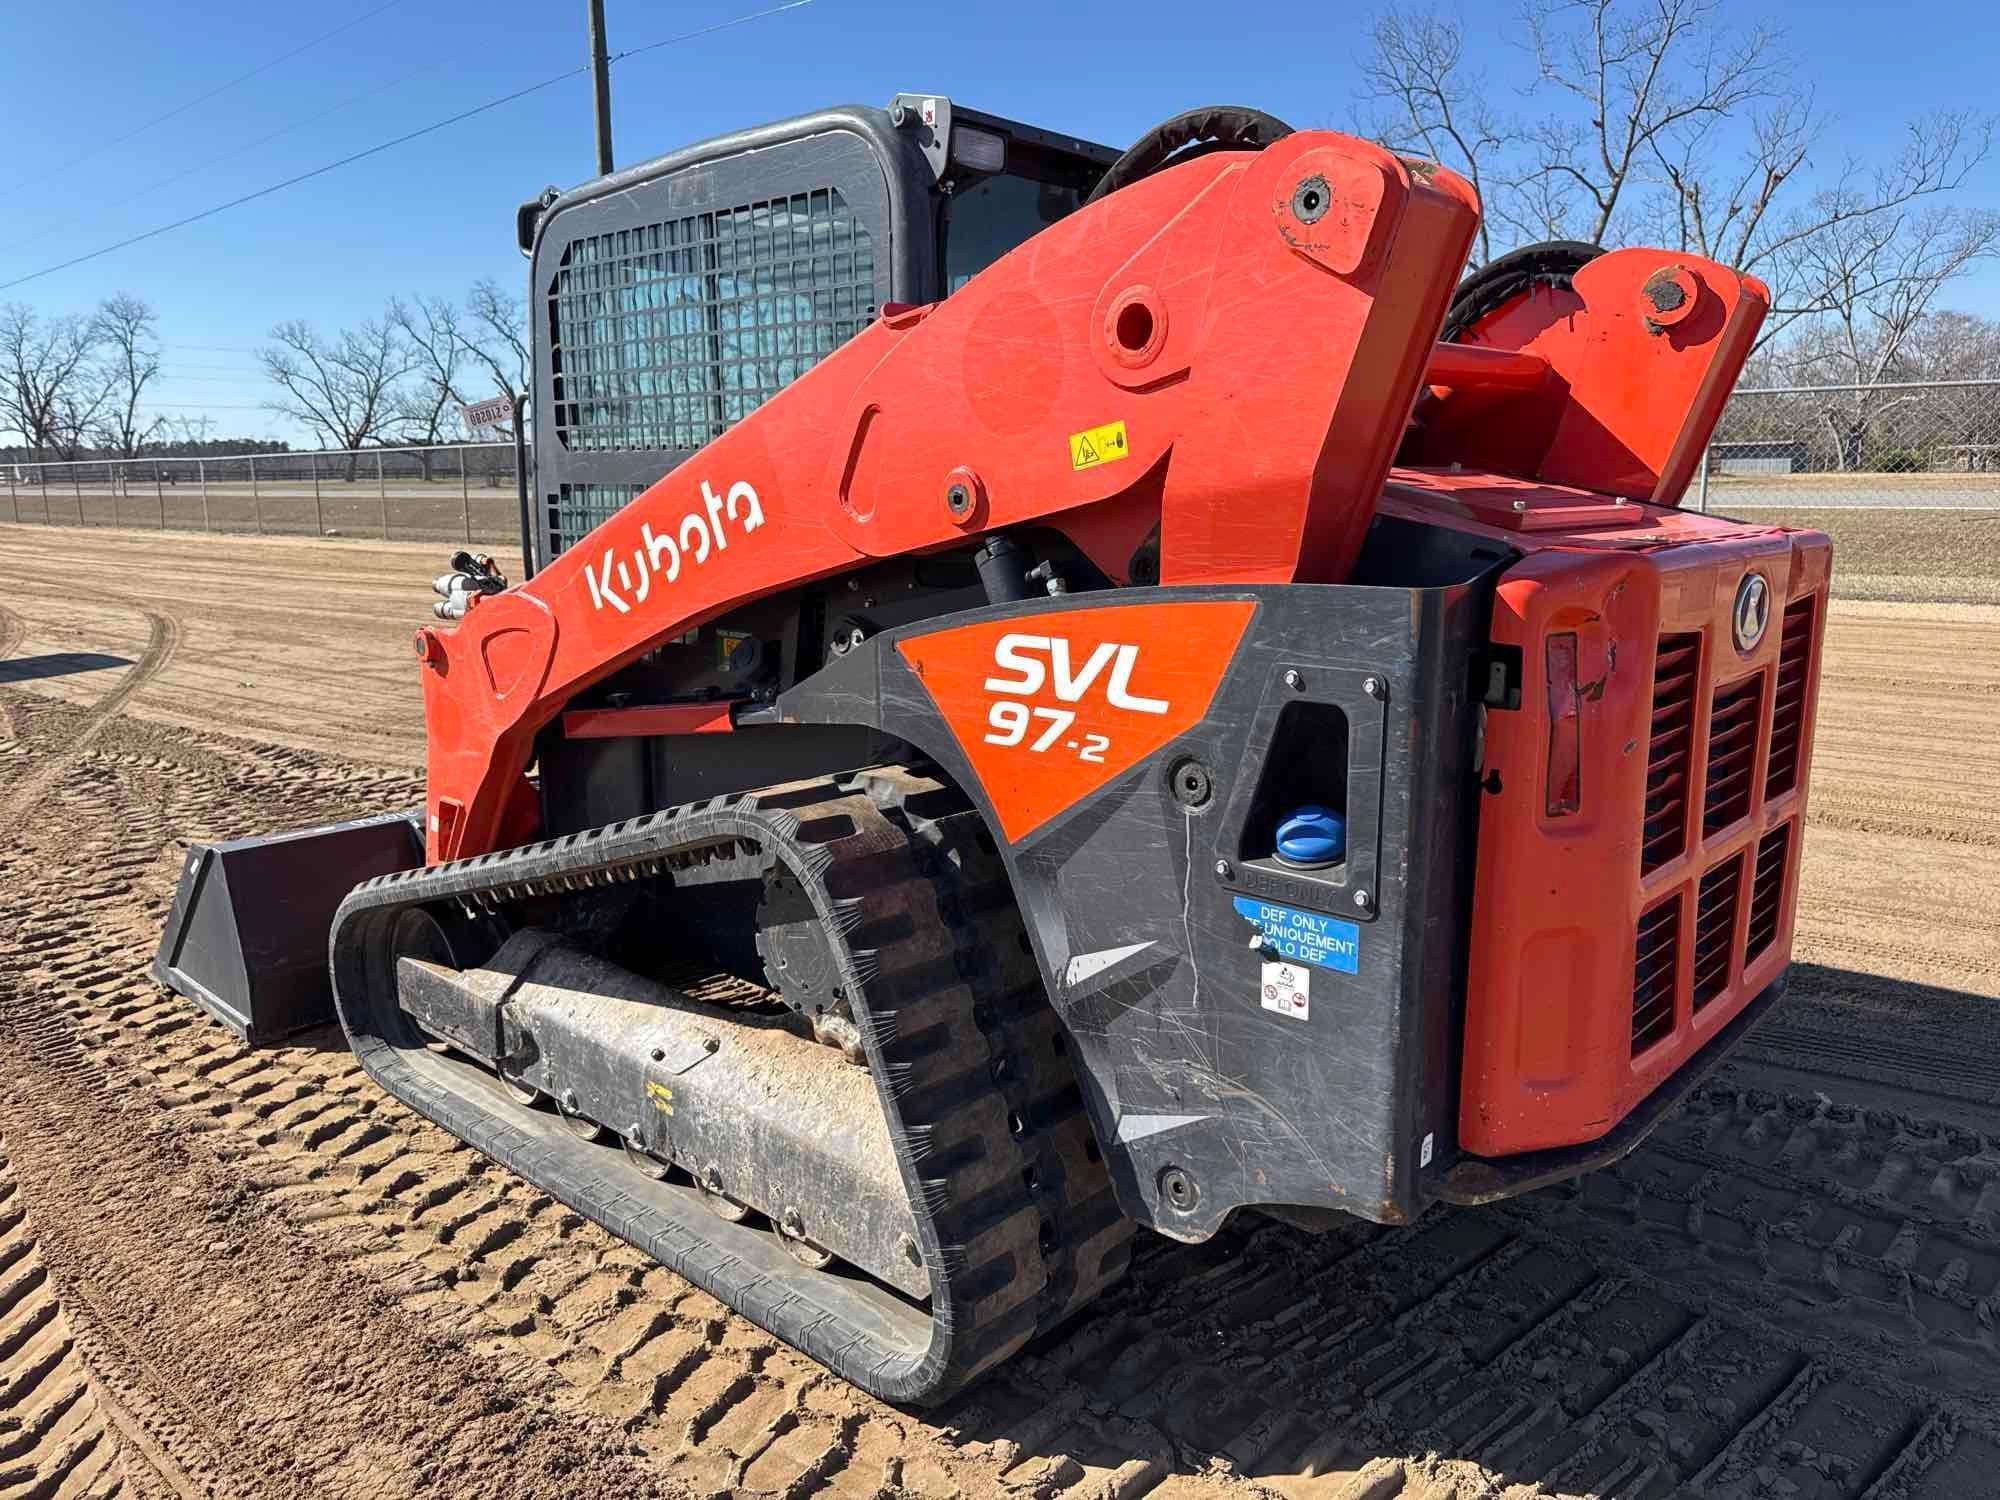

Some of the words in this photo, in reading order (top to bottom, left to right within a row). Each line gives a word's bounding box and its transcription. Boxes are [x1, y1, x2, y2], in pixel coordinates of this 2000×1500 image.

[585, 480, 766, 614] Kubota
[984, 633, 1169, 714] SVL
[984, 701, 1110, 763] 97-2
[1261, 906, 1287, 922] DEF
[1292, 914, 1328, 933] ONLY
[1264, 923, 1355, 955] UNIQUEMENT
[1300, 945, 1328, 961] DEF
